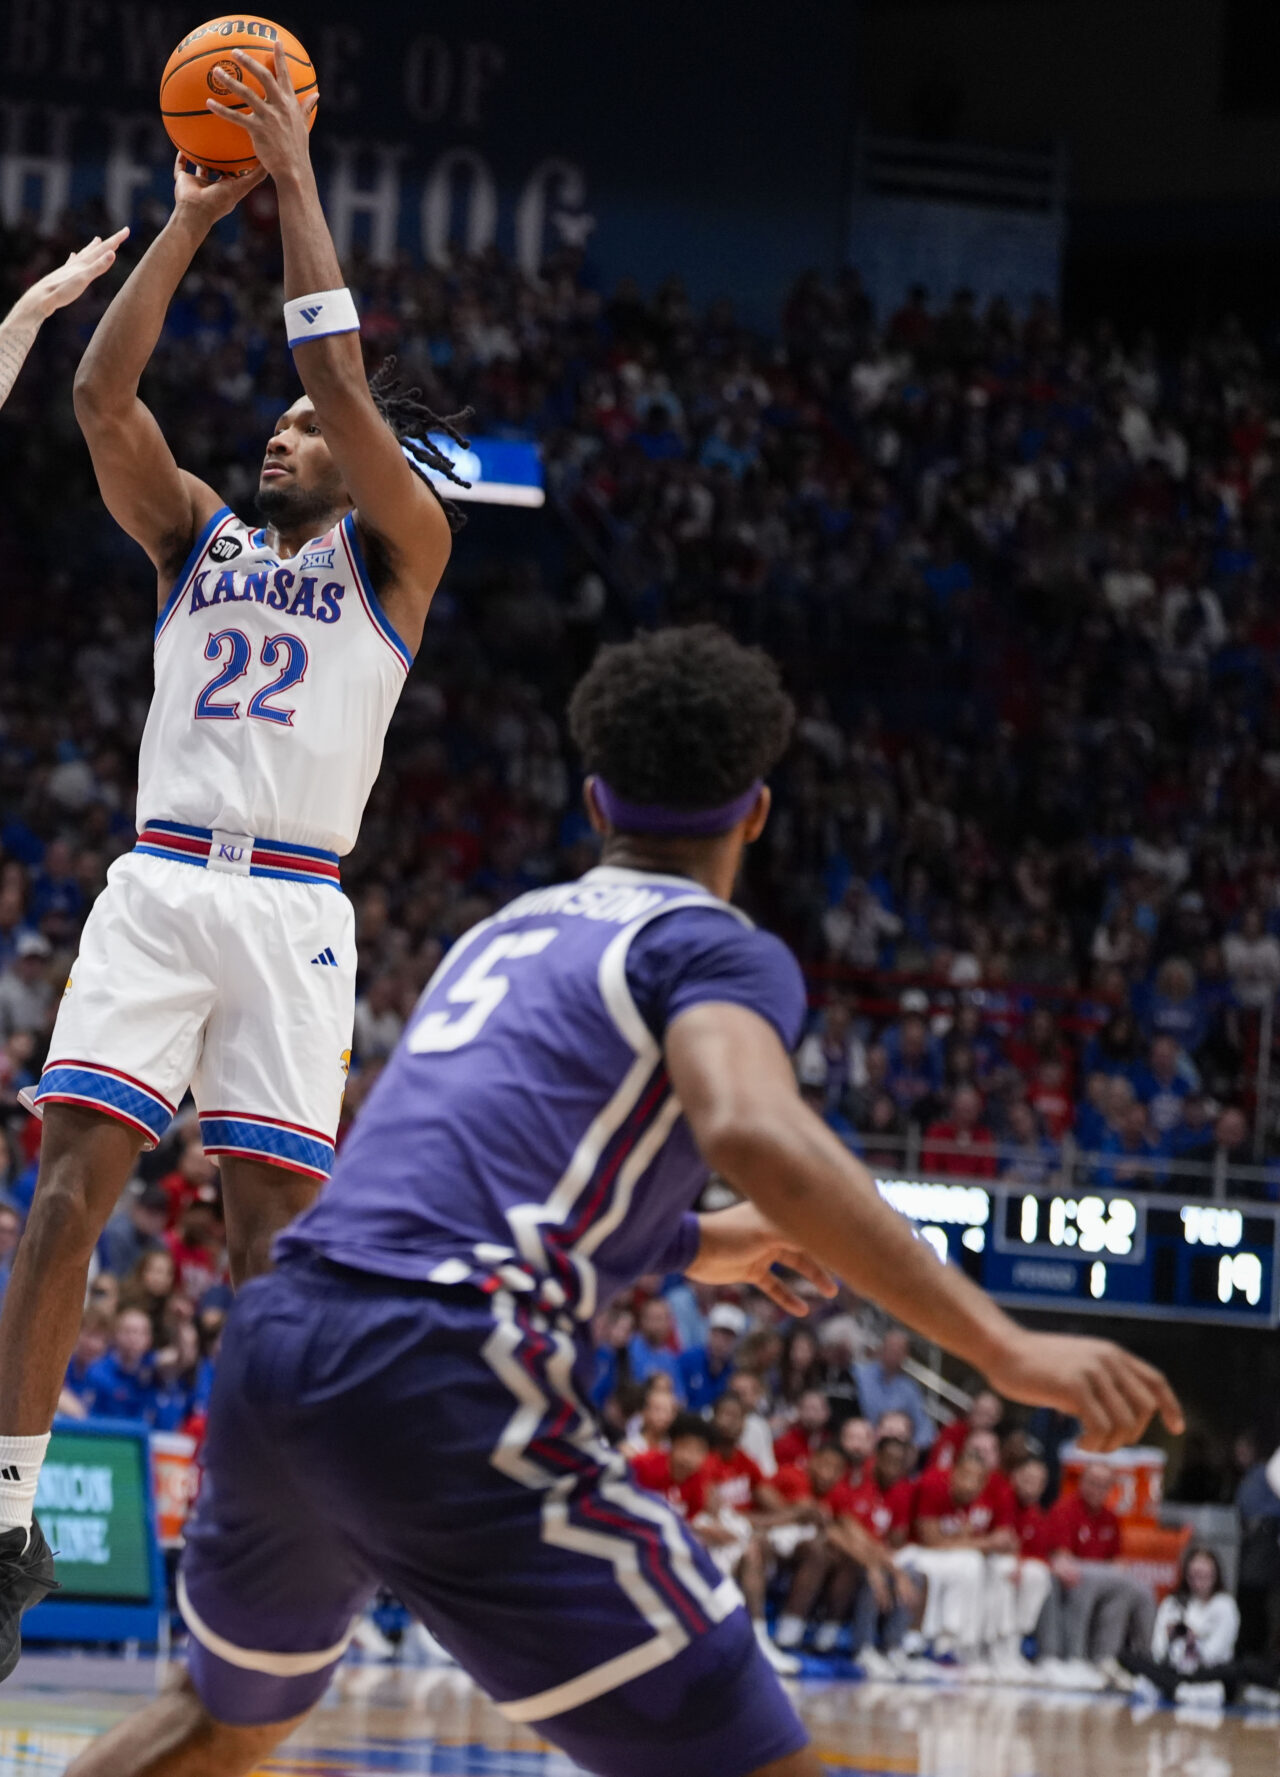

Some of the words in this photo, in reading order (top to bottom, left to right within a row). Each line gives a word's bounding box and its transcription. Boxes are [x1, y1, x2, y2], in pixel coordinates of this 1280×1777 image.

[177, 19, 278, 54] Wilson
[211, 538, 240, 560] SW
[189, 567, 346, 624] KANSAS
[193, 628, 309, 727] 22
[218, 842, 245, 863] KU
[407, 926, 560, 1056] 5
[1090, 1260, 1107, 1299] 1
